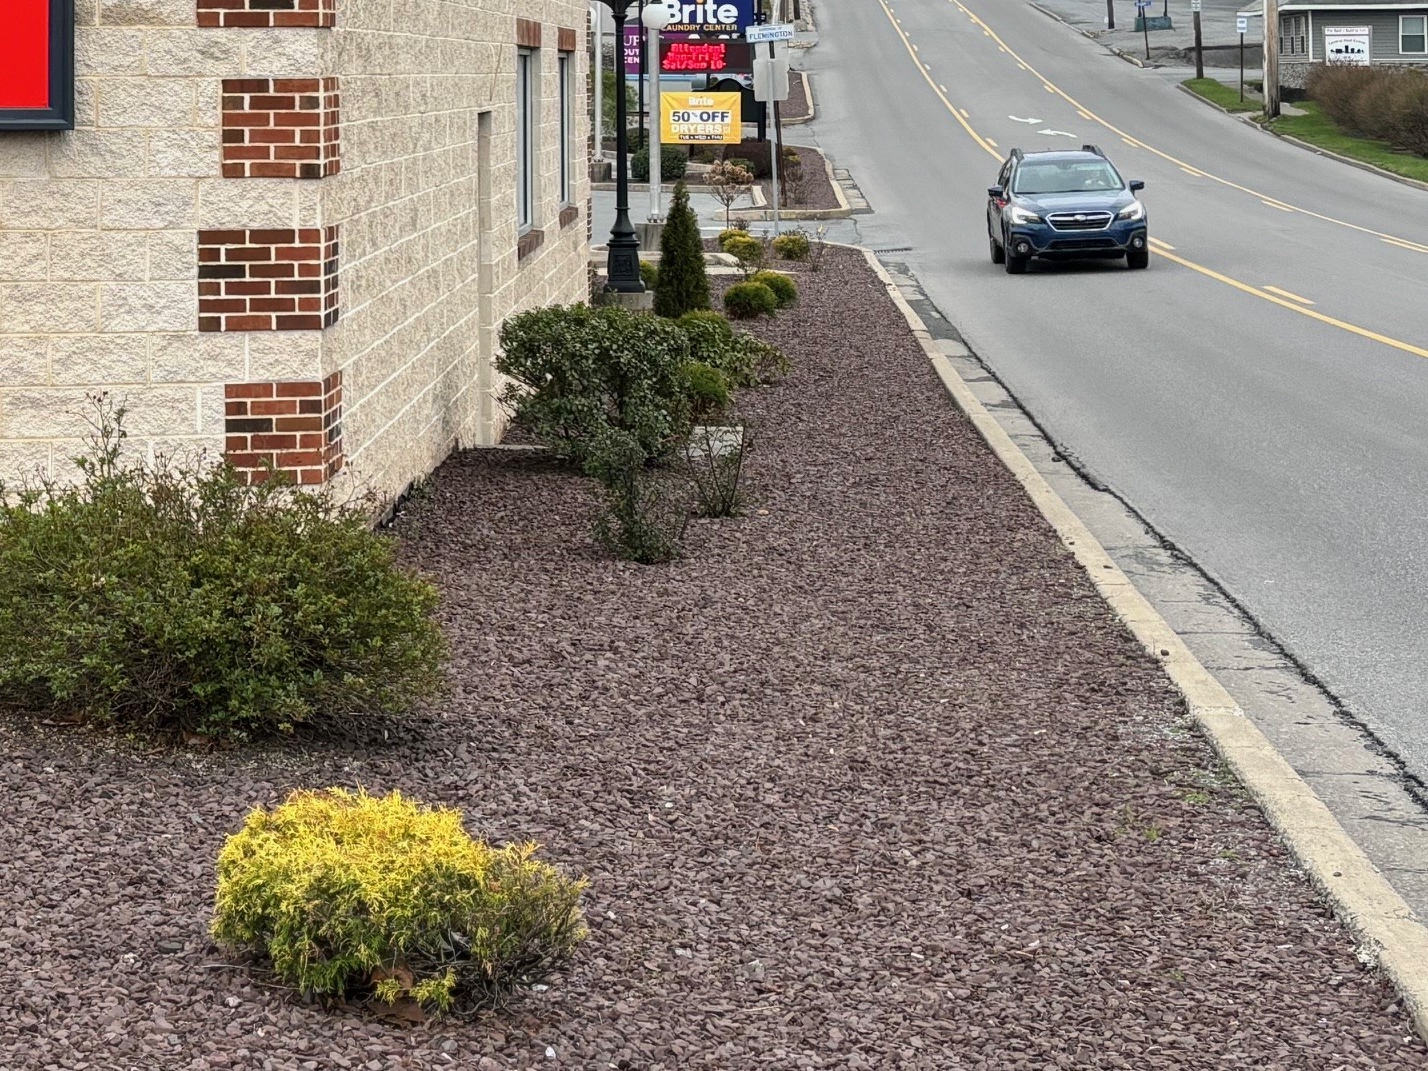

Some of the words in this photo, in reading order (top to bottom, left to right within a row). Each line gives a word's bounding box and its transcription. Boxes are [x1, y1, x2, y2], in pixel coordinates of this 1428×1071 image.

[703, 24, 738, 32] CENTER
[749, 31, 793, 40] FLEMINGTON
[671, 43, 726, 53] Attendant
[699, 111, 730, 123] OFF
[671, 124, 722, 134] DRYERS
